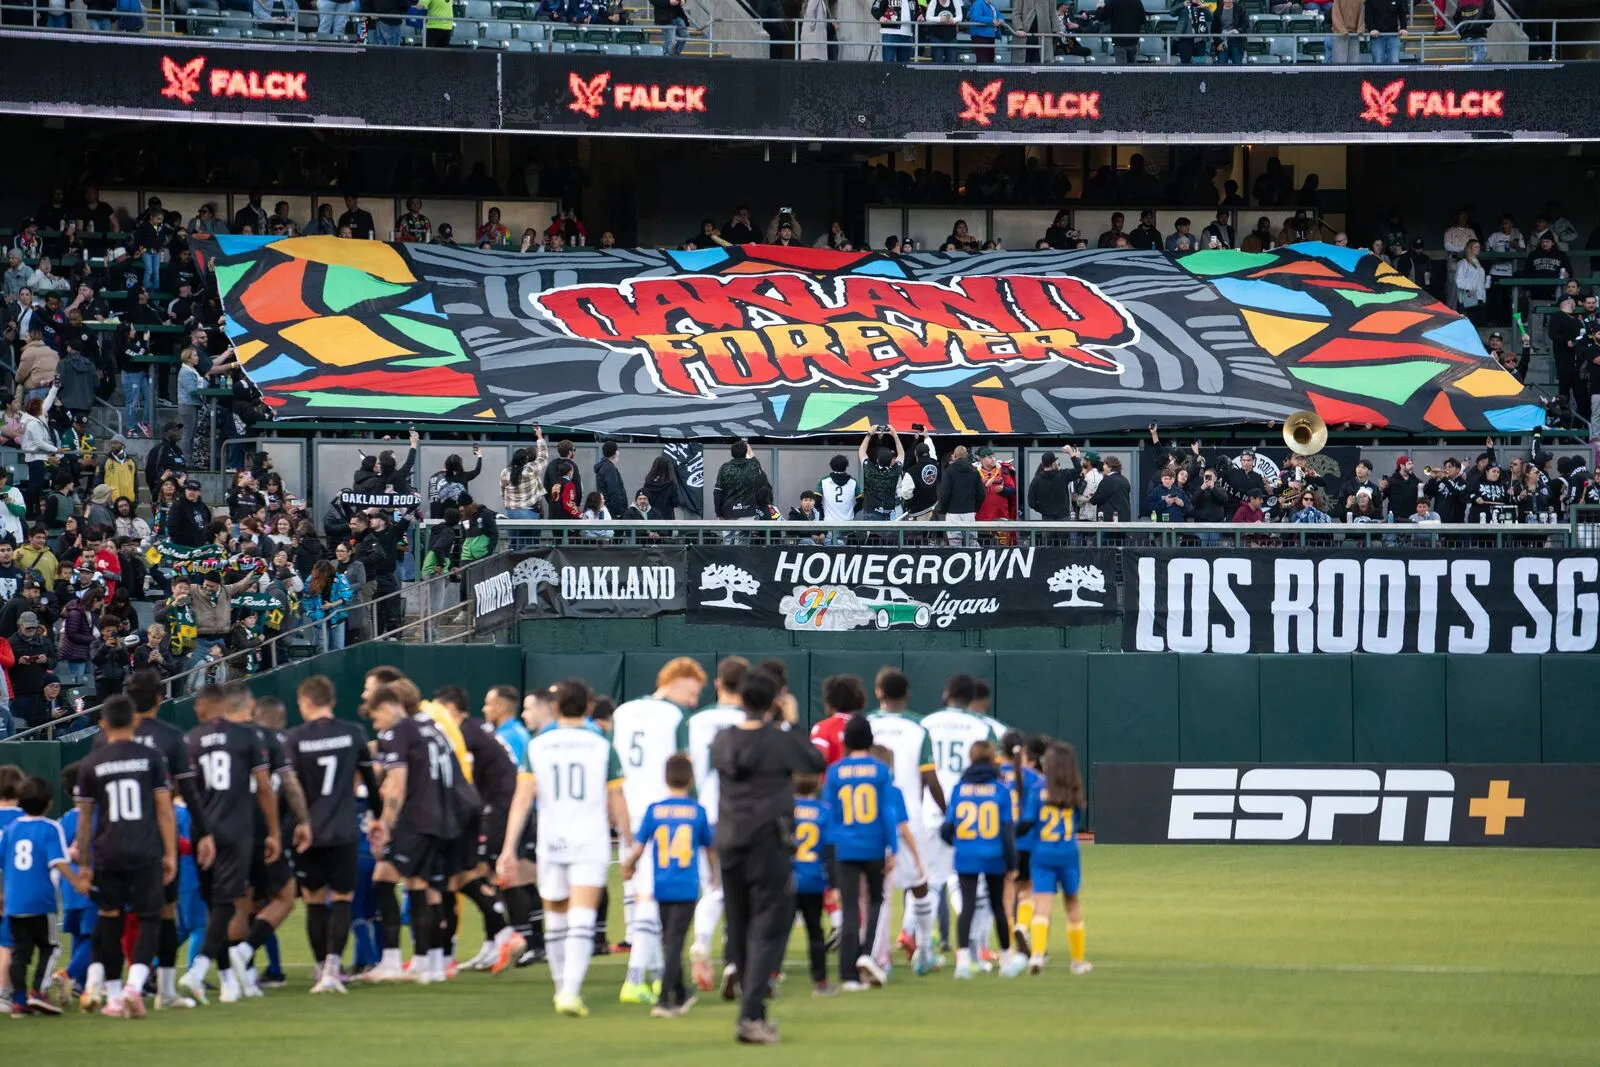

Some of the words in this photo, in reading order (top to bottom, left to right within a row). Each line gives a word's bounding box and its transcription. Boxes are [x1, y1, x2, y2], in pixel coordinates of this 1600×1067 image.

[210, 68, 308, 101] FALCK
[613, 83, 707, 113] FALCK
[1006, 90, 1101, 119] FALCK
[1406, 90, 1504, 118] FALCK
[533, 273, 1132, 344] OAKLAND
[634, 320, 1120, 397] FOREVER
[341, 493, 390, 506] OAKLAND
[834, 486, 844, 503] 2
[560, 565, 676, 601] OAKLAND
[774, 547, 1036, 586] HOMEGROWN
[474, 570, 514, 618] FOREVER
[1135, 557, 1252, 654] LOS
[1271, 557, 1491, 654] ROOTS
[1511, 556, 1599, 653] SG
[628, 731, 646, 768] 5
[934, 740, 964, 773] 15
[198, 750, 232, 791] 18
[317, 755, 338, 796] 7
[550, 763, 586, 801] 10
[105, 779, 143, 822] 10
[838, 783, 877, 825] 10
[1168, 768, 1526, 842] ESPN+
[955, 801, 1000, 840] 20
[1039, 805, 1074, 842] 21
[14, 839, 33, 872] 8
[654, 825, 693, 869] 14
